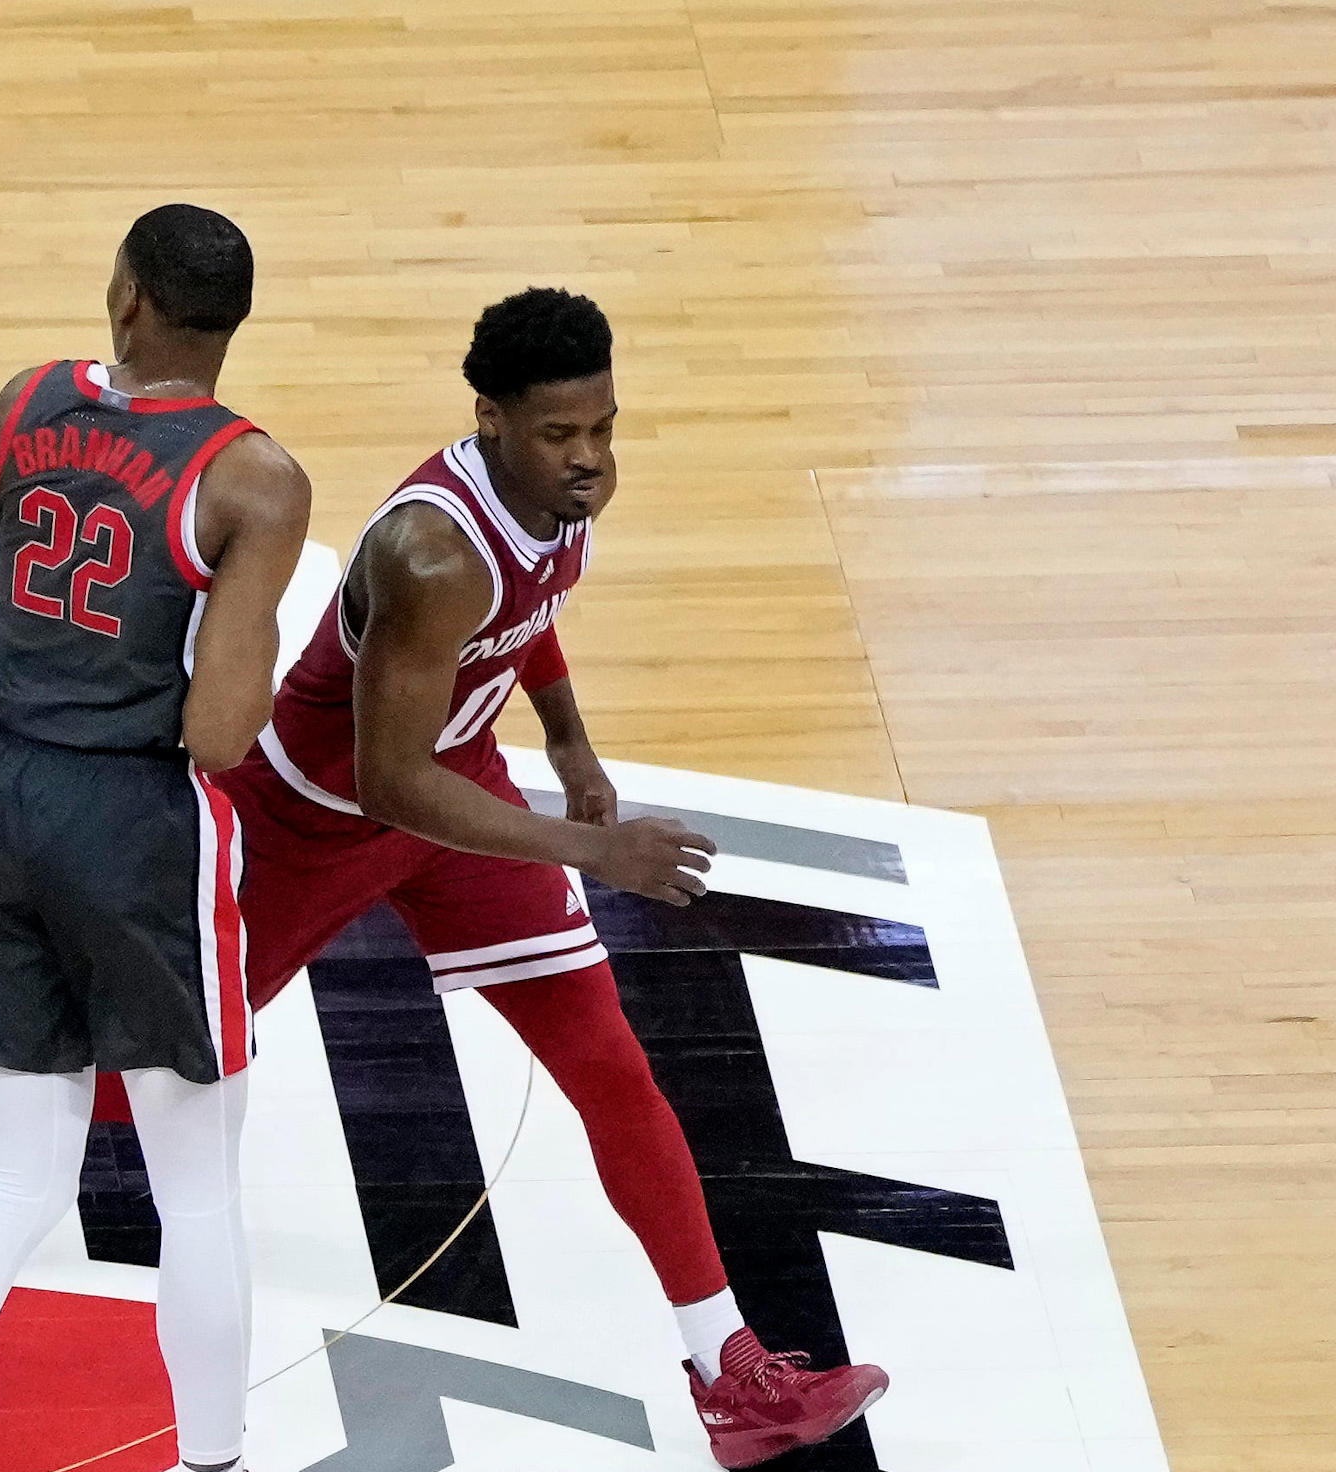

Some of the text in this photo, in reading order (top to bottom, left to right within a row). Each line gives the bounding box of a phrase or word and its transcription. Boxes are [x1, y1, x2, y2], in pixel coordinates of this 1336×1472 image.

[12, 424, 175, 511] BRANHAM
[12, 486, 134, 639] 22
[459, 588, 571, 668] INDIAN
[434, 666, 517, 754] 0
